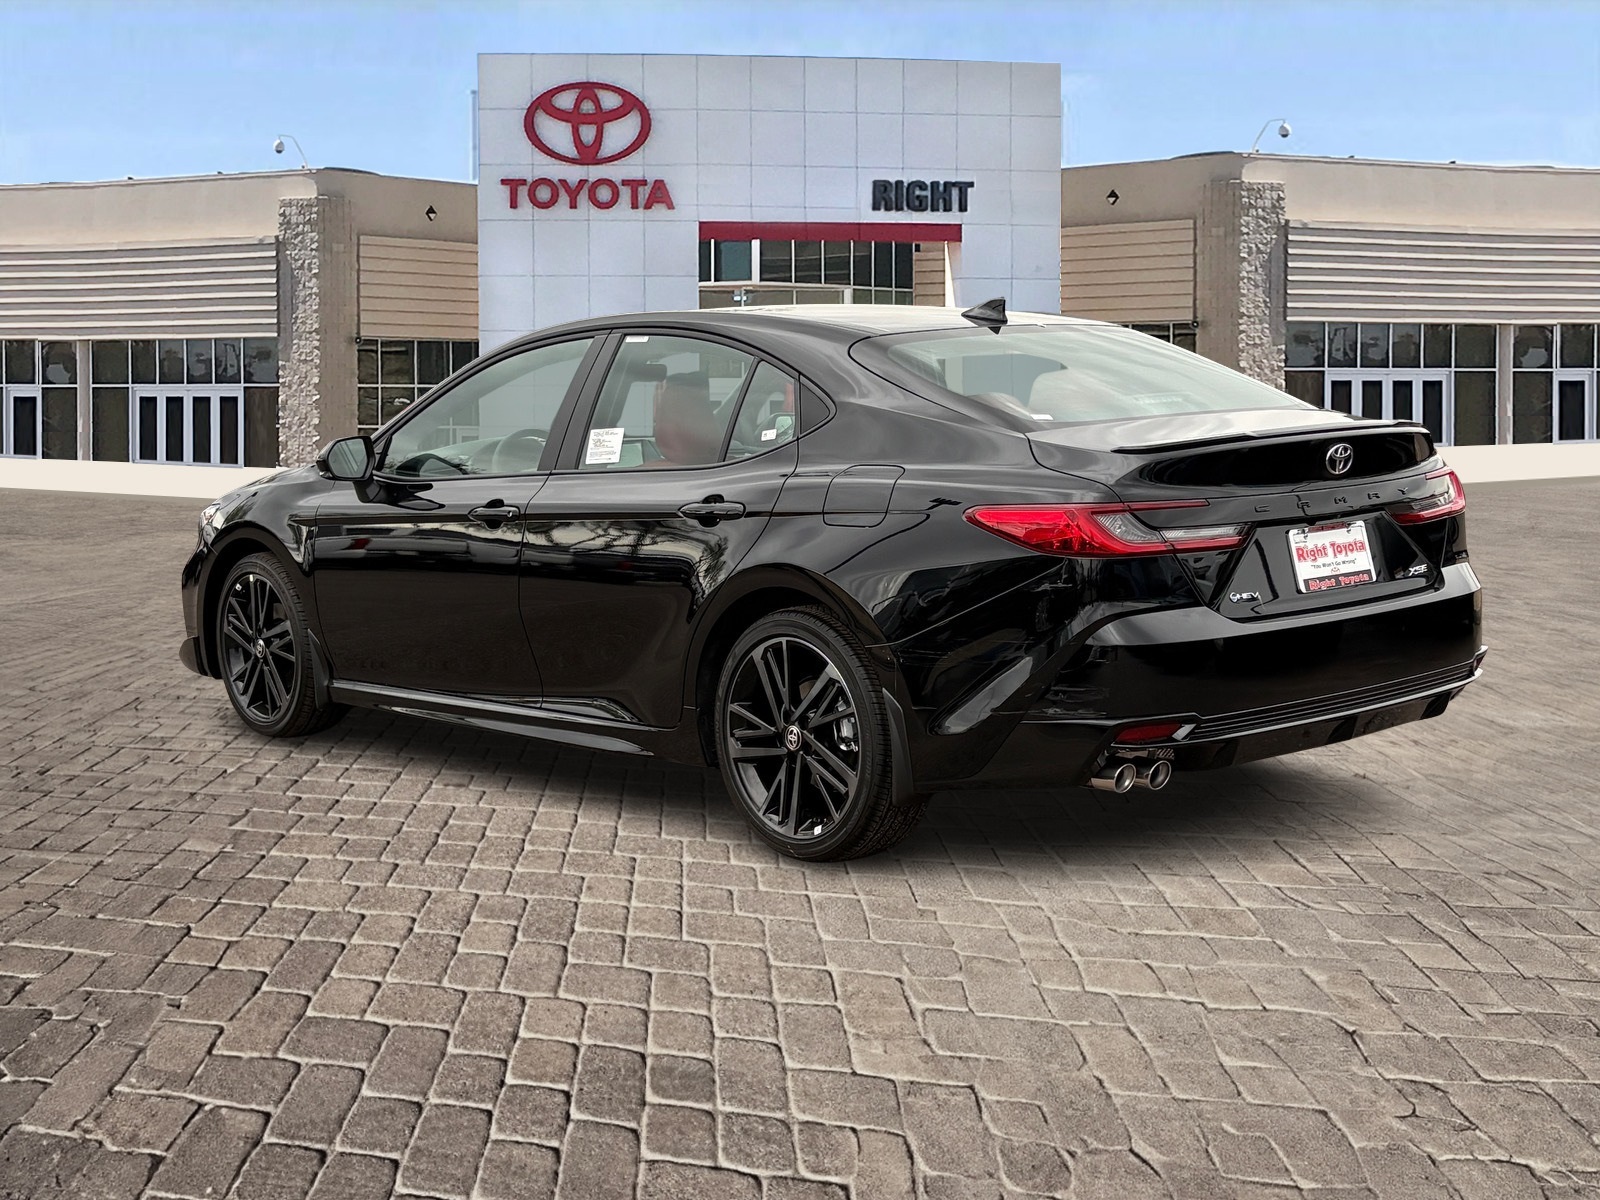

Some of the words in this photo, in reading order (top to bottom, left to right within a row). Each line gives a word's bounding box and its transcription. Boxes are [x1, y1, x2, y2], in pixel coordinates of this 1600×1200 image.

[500, 178, 675, 210] TOYOTA
[872, 180, 975, 212] RIGHT
[1295, 544, 1328, 562] Right
[1329, 539, 1366, 558] Toyota
[1309, 578, 1336, 590] Right
[1339, 574, 1369, 586] Toyota
